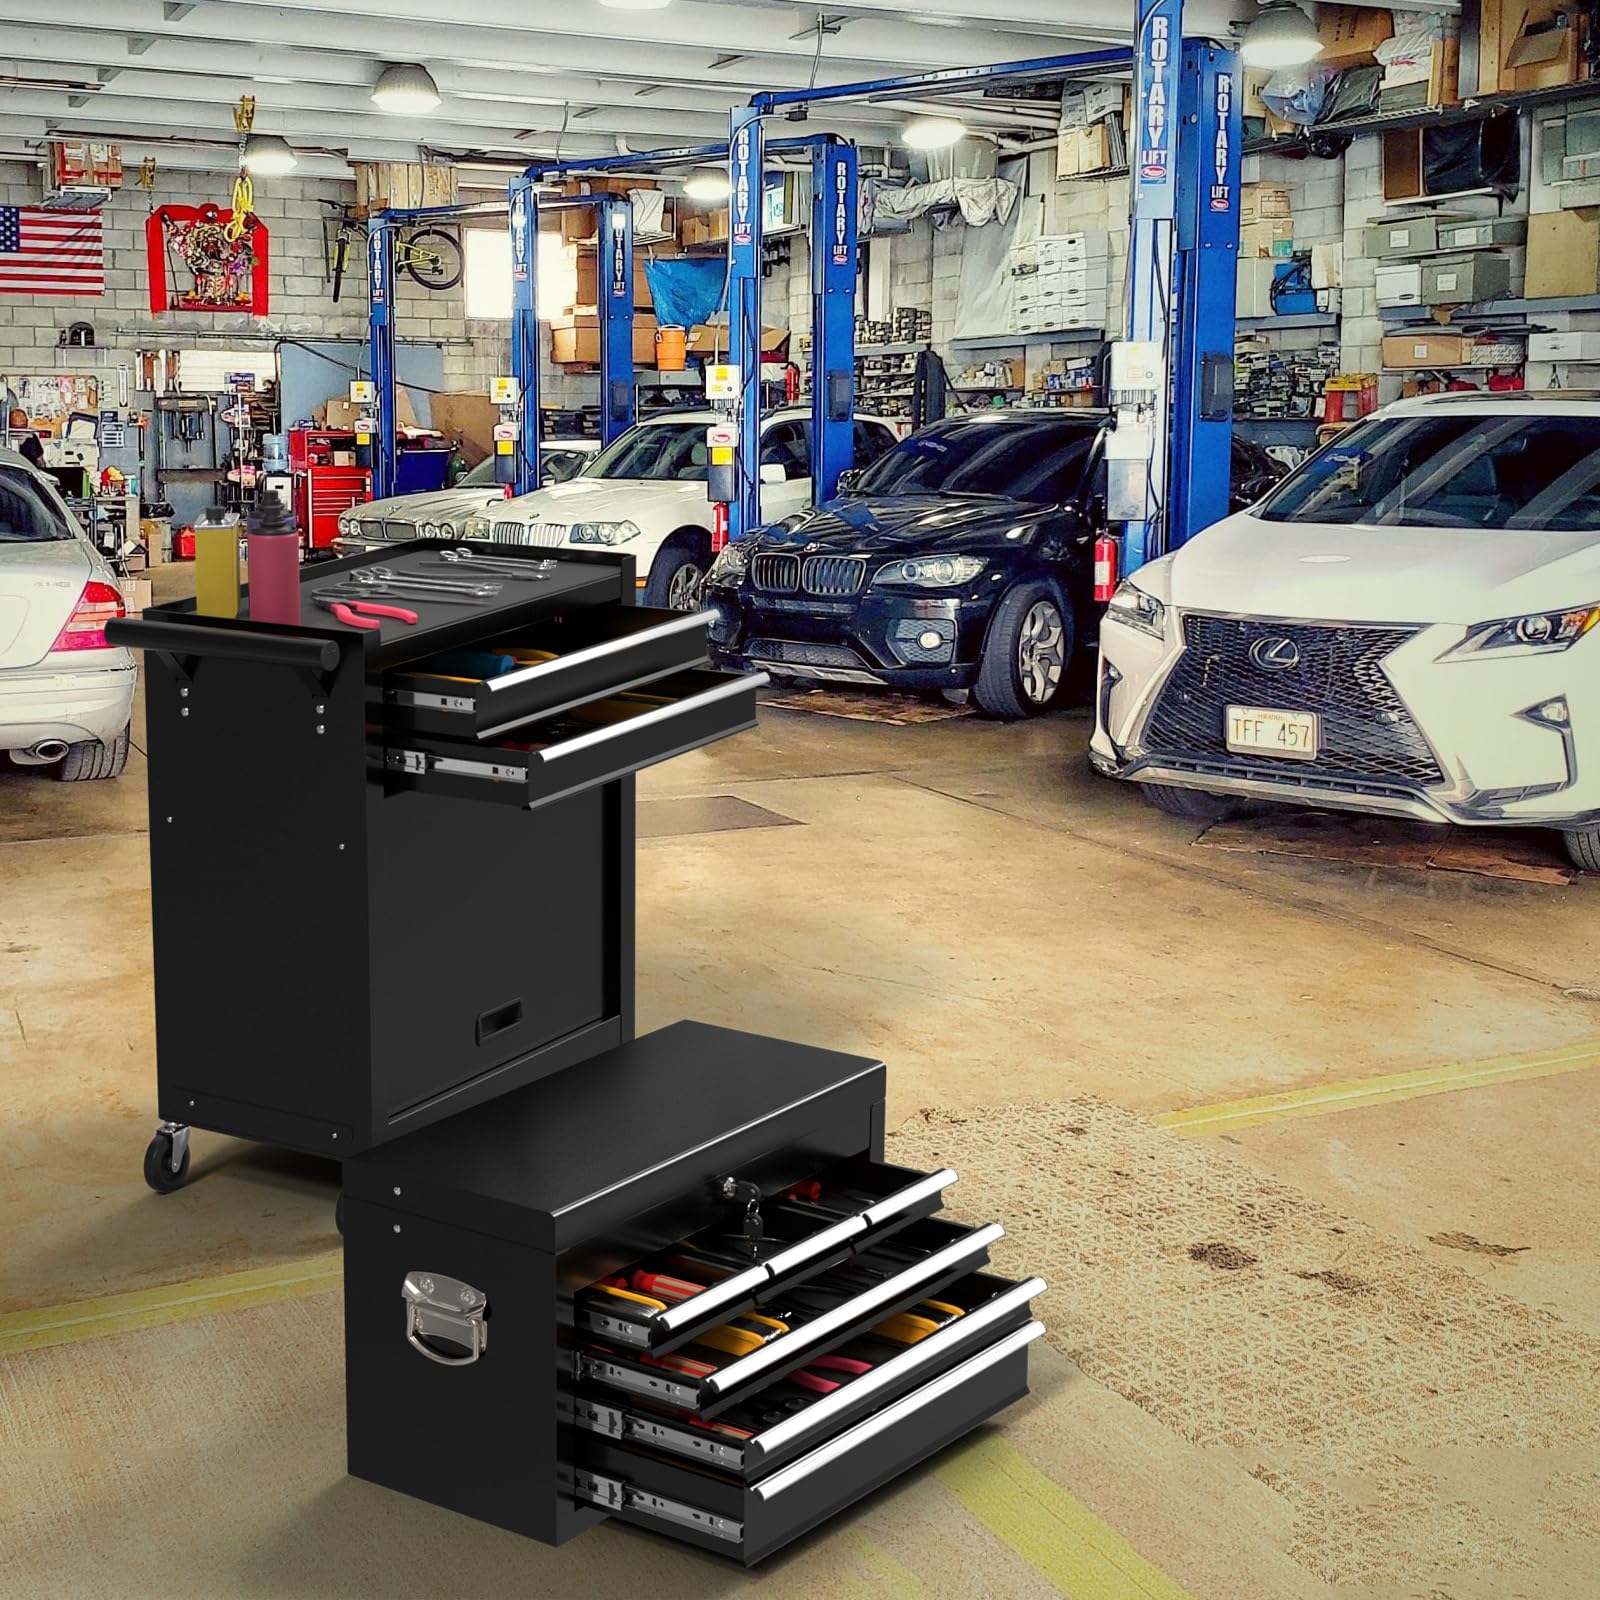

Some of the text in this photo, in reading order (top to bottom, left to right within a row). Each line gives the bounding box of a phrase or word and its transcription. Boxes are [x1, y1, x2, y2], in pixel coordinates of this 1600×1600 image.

[1148, 16, 1168, 148] ROTARY
[1142, 151, 1167, 164] LIFT
[1215, 75, 1230, 184] ROTARY
[737, 128, 749, 222] ROTARY
[836, 162, 846, 244] ROTARY
[1211, 186, 1229, 198] LIFT
[515, 190, 524, 263] ROARY
[615, 215, 623, 281] OTARY
[734, 223, 751, 234] LIFT
[833, 245, 848, 255] LIFT
[1233, 719, 1310, 748] TFF 457
